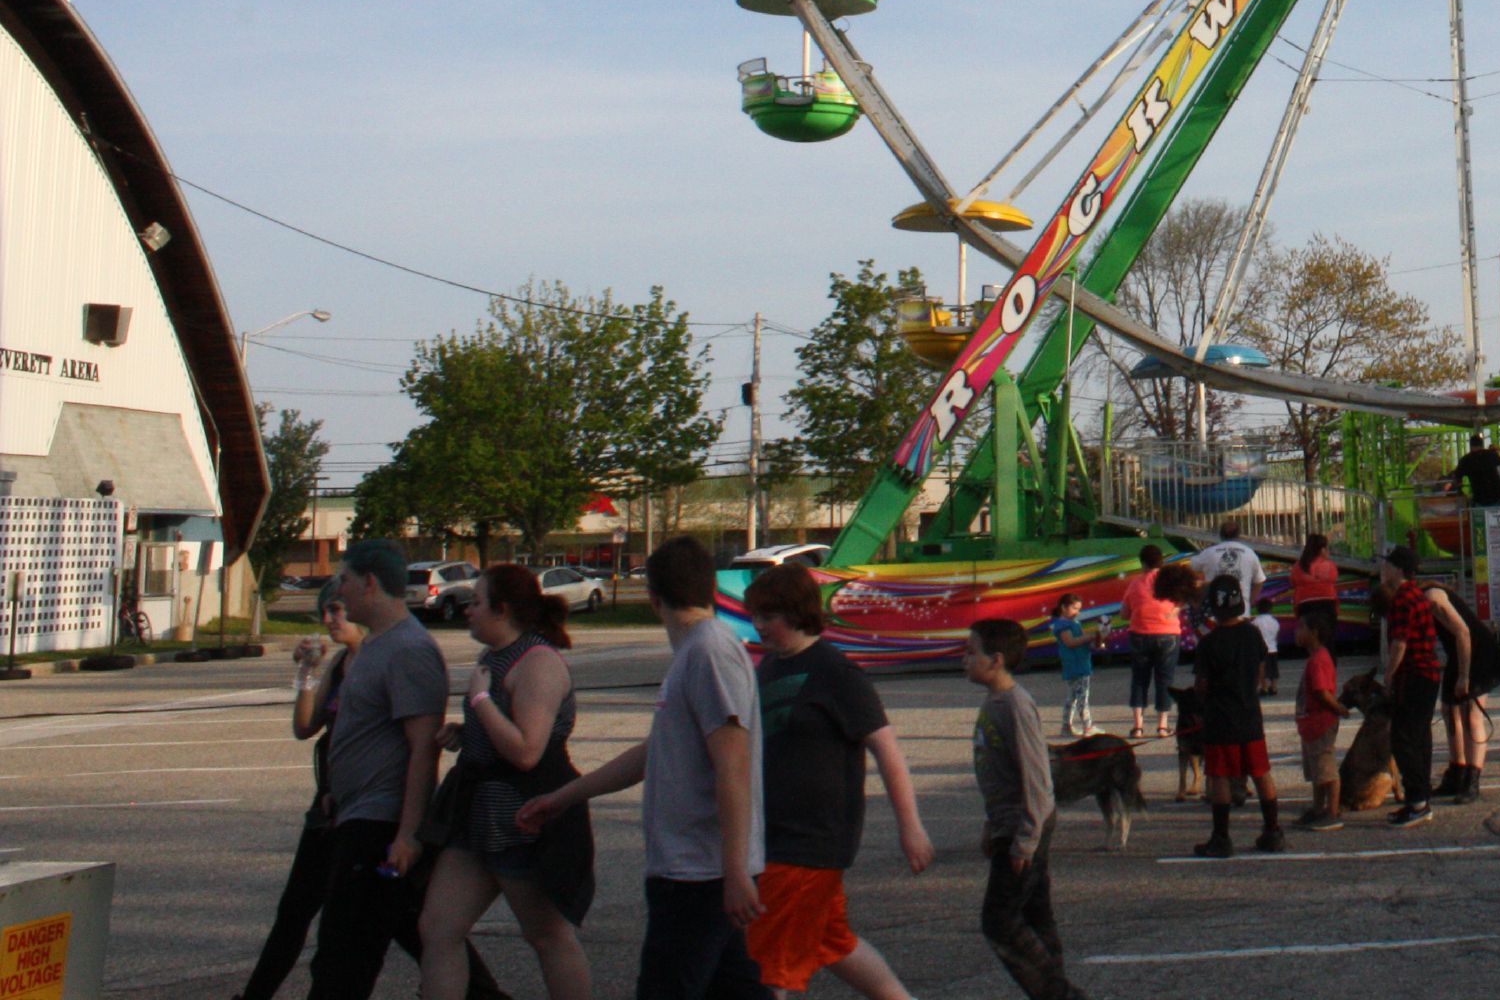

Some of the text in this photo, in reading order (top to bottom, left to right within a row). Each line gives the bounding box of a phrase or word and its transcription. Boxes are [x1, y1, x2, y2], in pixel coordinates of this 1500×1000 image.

[60, 358, 100, 382] ARENA
[7, 921, 66, 953] DANGER
[16, 945, 51, 972] HIGH
[0, 962, 62, 996] VOLTAGE
